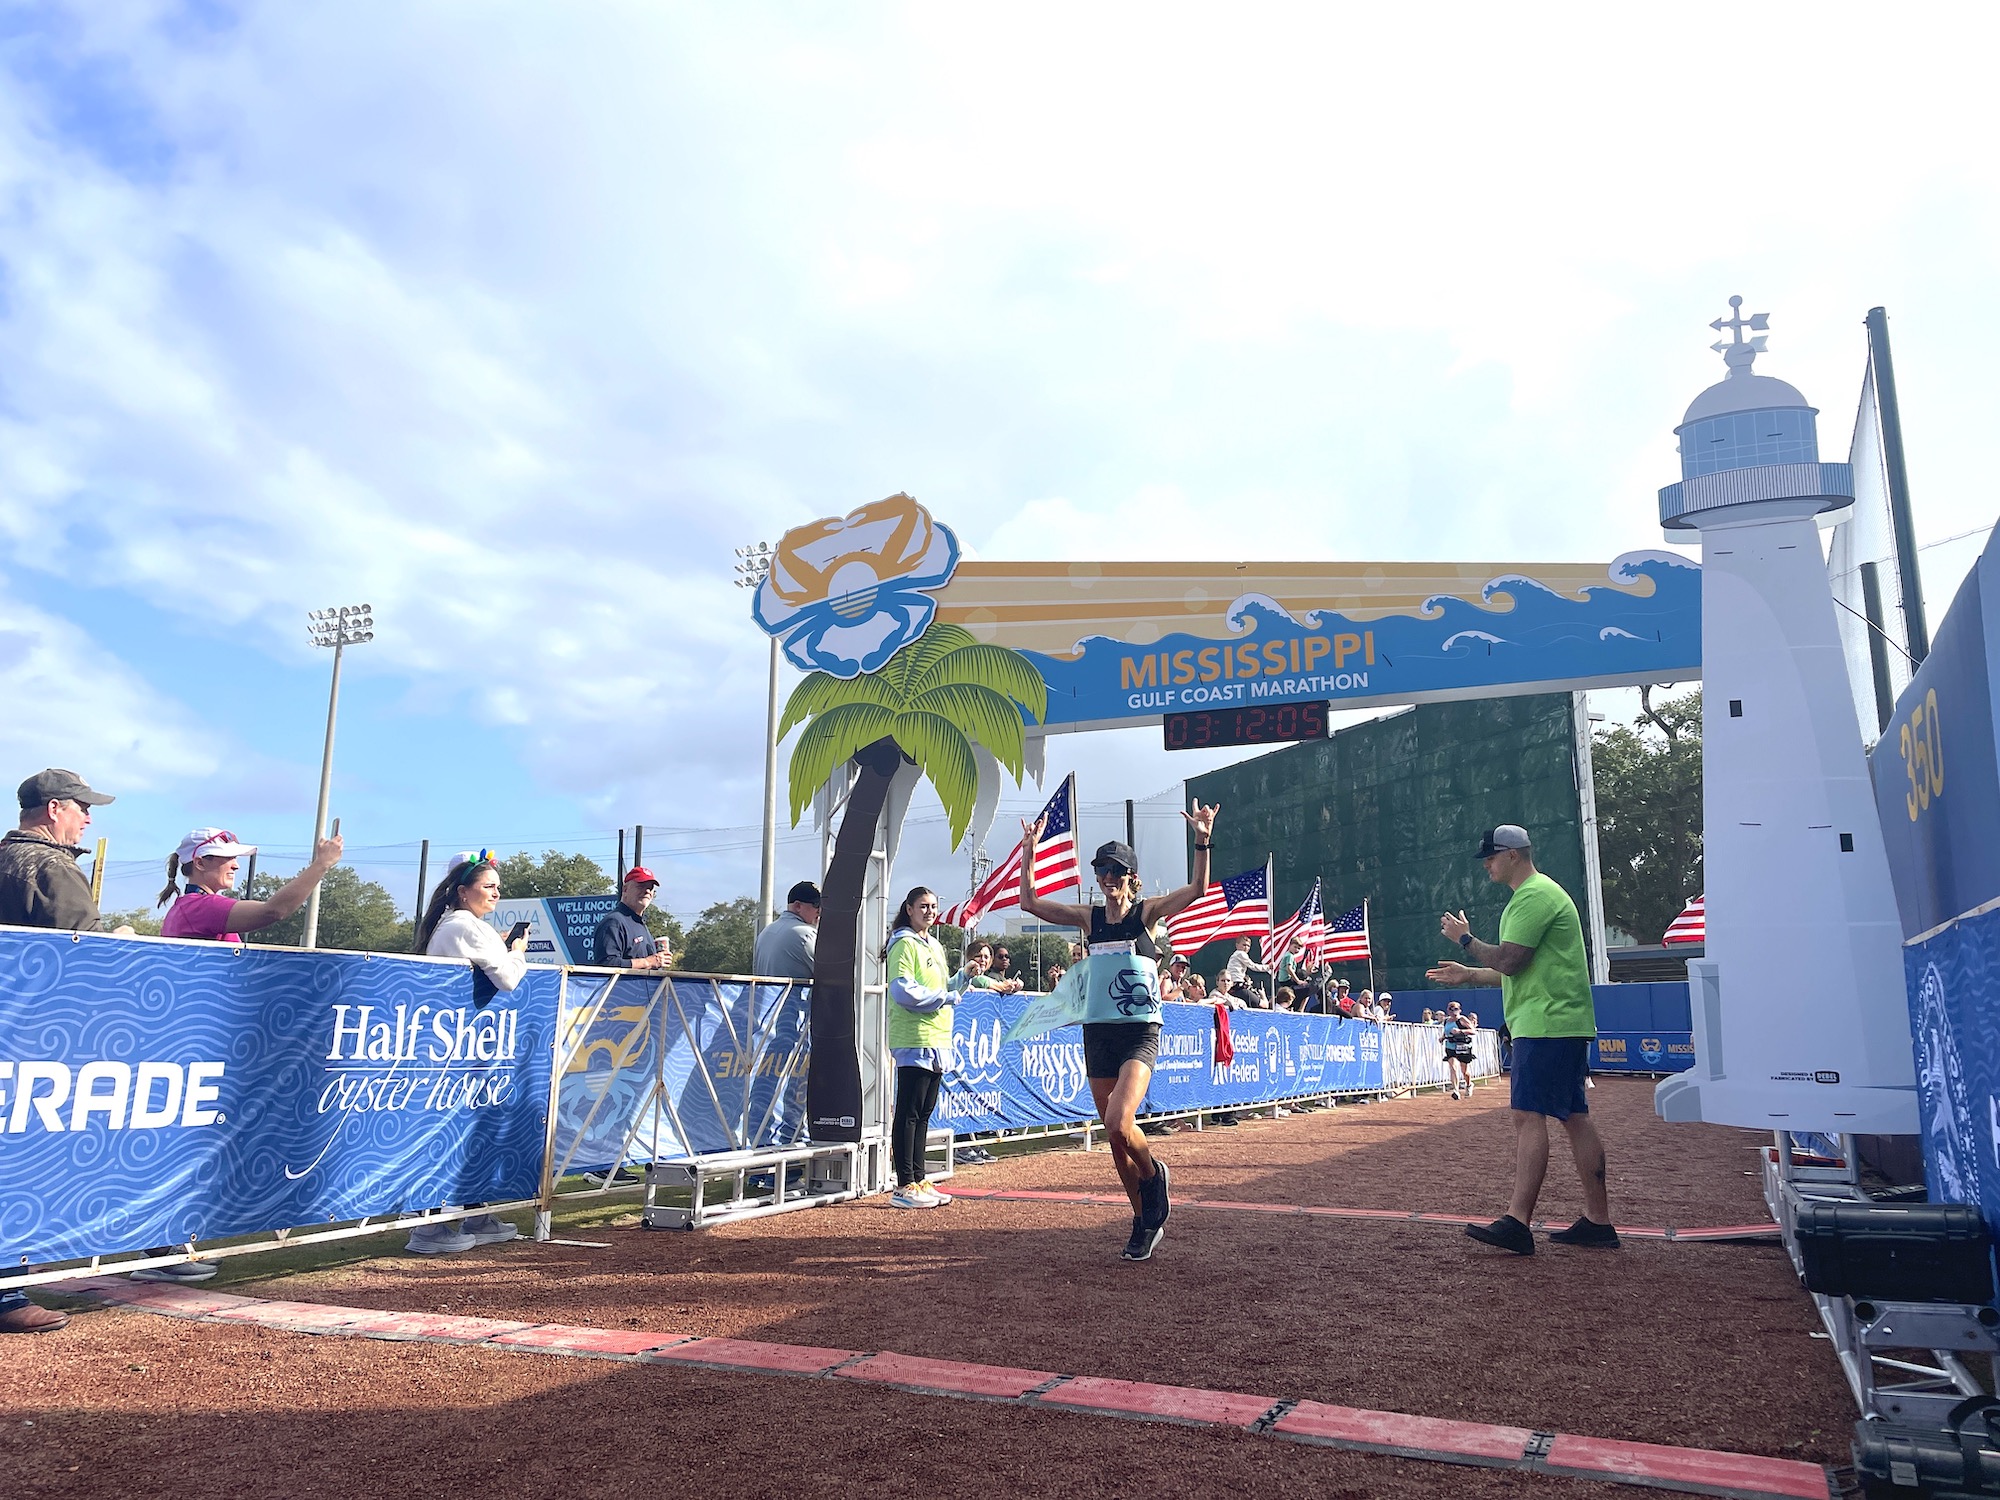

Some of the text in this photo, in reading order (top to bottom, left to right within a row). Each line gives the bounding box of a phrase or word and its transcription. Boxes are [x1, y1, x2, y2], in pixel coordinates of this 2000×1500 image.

[1121, 631, 1375, 689] MISSISSIPPI
[1127, 672, 1369, 709] GULF COAST MARATHON
[1900, 687, 1944, 822] 350
[483, 909, 541, 927] ENOVA
[557, 900, 618, 912] WE'LL KNOCK
[566, 914, 592, 924] YOUR
[526, 942, 551, 950] DENTIAL
[326, 1004, 517, 1061] Half Shell
[1230, 1029, 1259, 1053] Keesler
[952, 1019, 1002, 1073] stal
[1598, 1039, 1626, 1052] RUN
[1667, 1044, 1694, 1053] MISSIS
[1230, 1058, 1260, 1083] Federal
[424, 1061, 514, 1111] house
